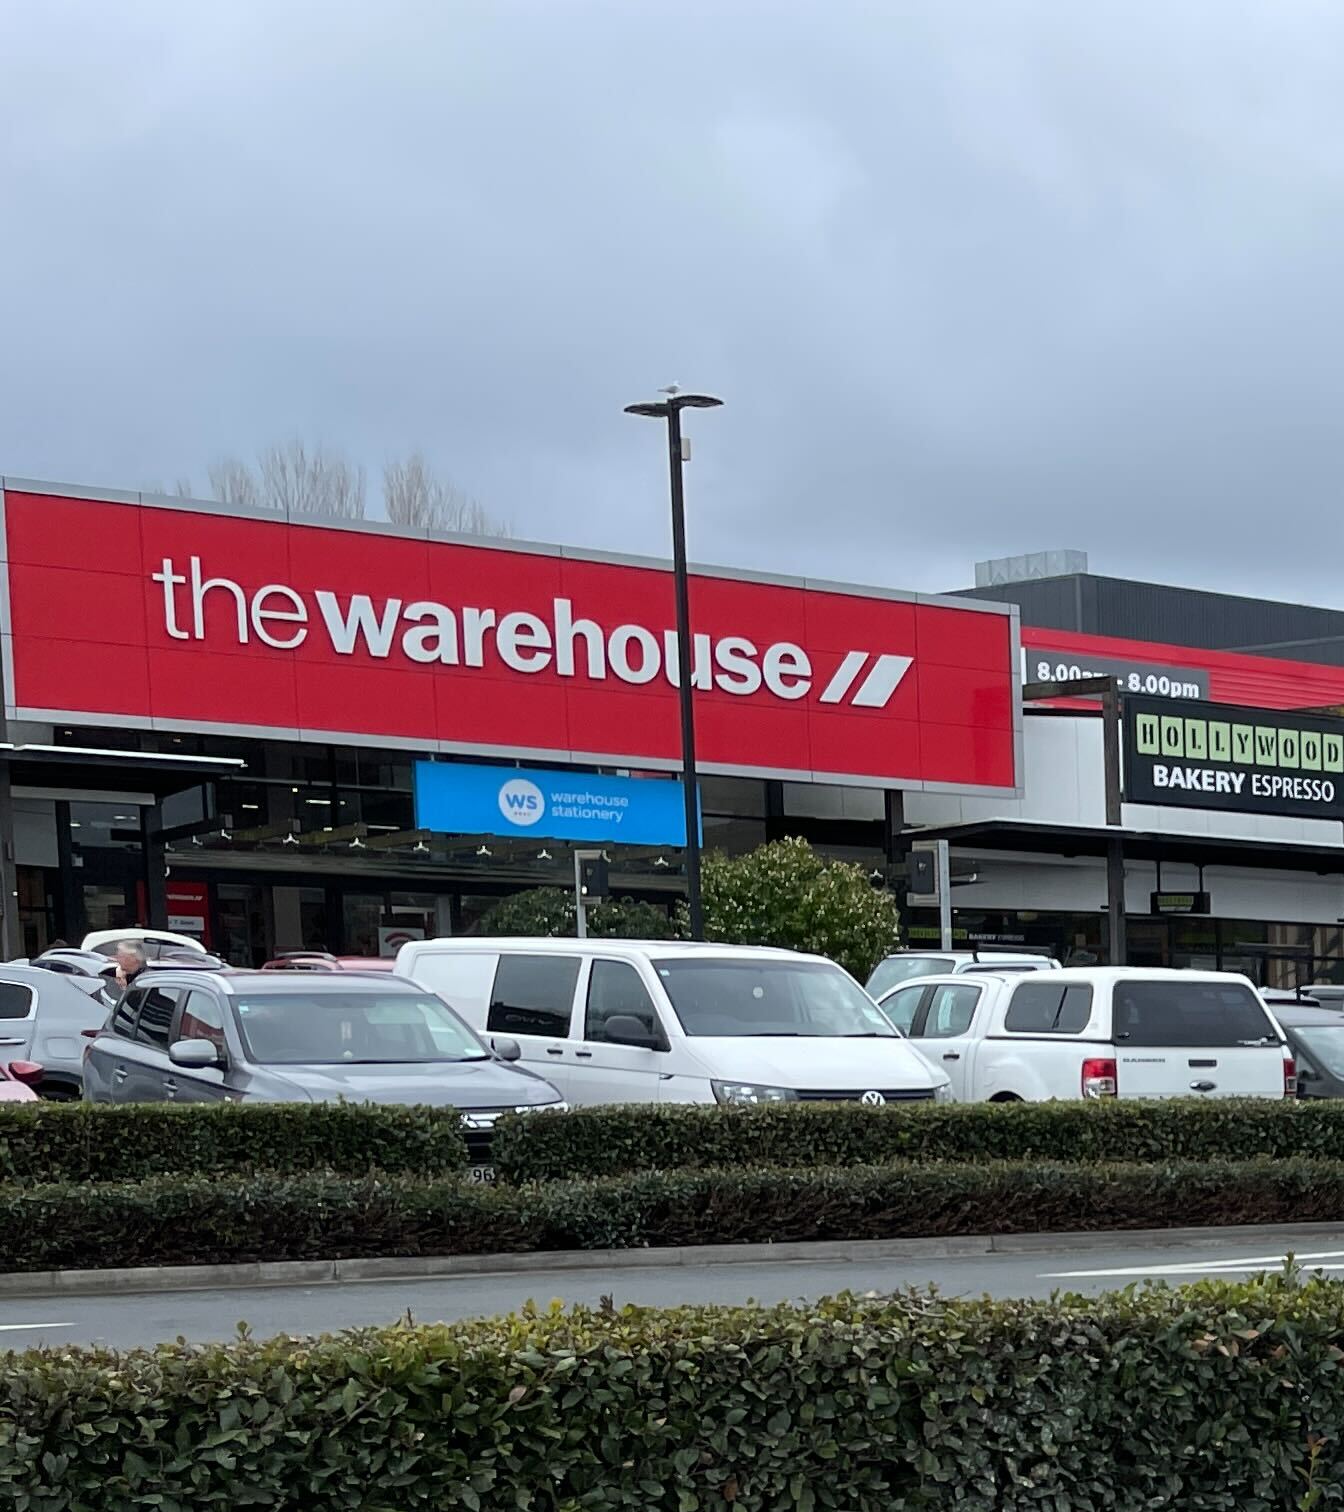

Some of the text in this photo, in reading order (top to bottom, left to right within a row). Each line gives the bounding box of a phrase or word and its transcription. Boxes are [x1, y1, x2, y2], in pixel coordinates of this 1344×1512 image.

[152, 556, 812, 700] the warehouse
[1127, 673, 1199, 698] 8.00pm
[1141, 721, 1340, 764] HOLLYWOOD
[1153, 764, 1335, 802] BAKERY ESPRESSO
[506, 793, 537, 810] WS
[551, 791, 629, 807] warehouse
[551, 805, 624, 822] stationery
